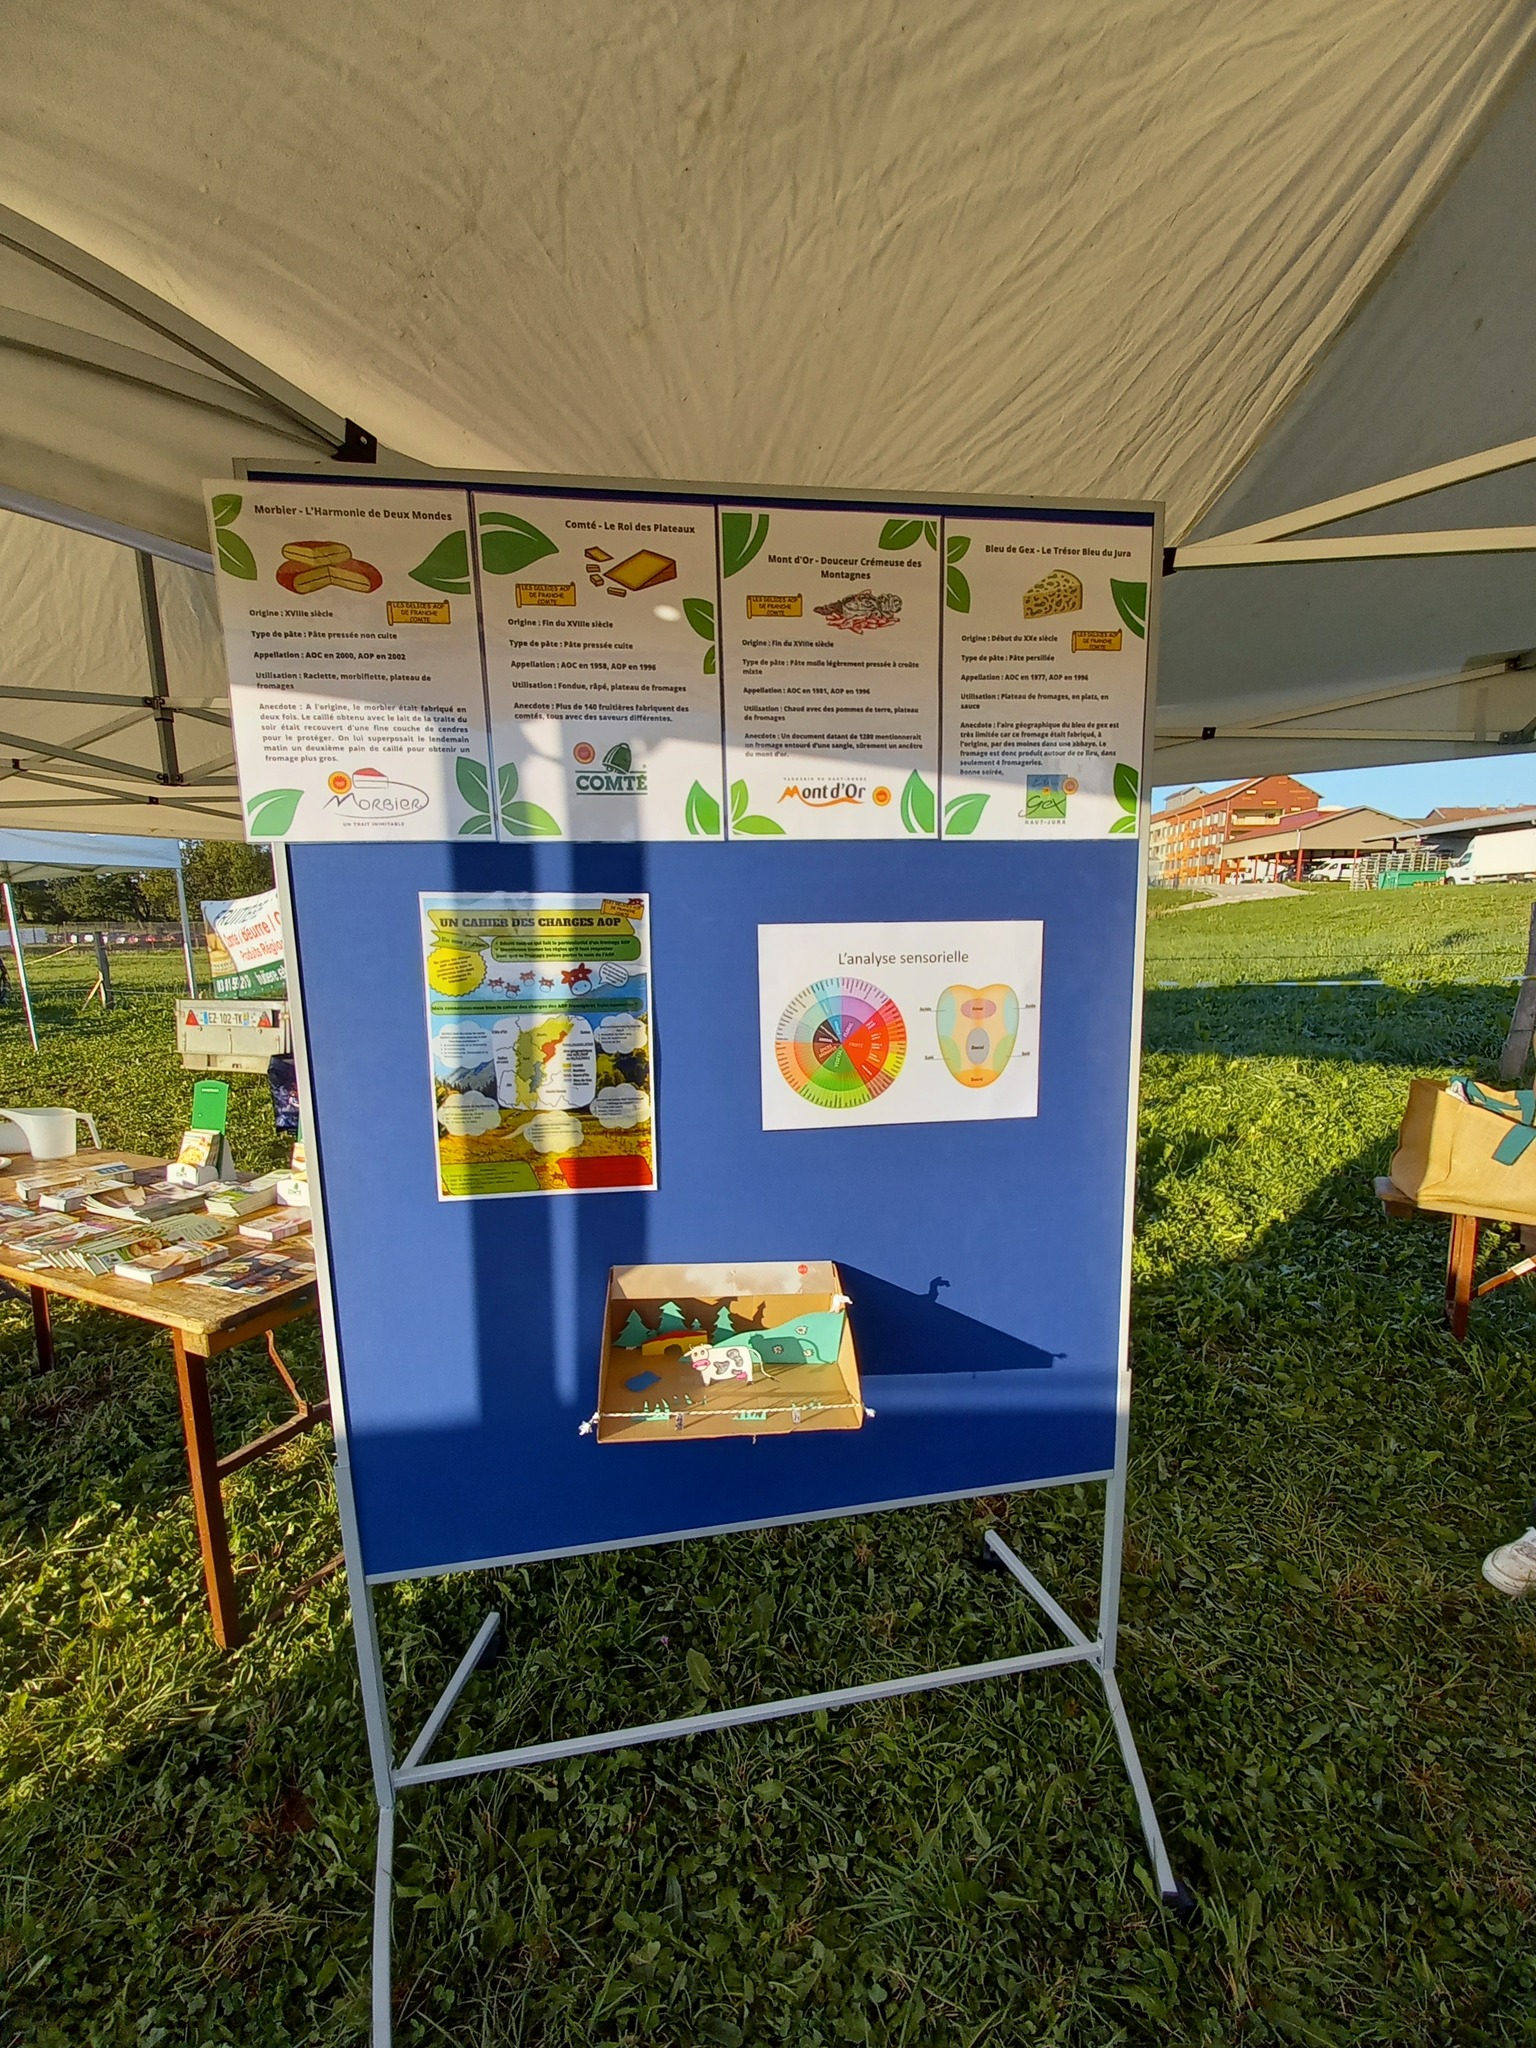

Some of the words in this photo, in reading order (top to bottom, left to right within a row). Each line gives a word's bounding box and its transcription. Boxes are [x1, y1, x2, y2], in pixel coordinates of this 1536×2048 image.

[254, 504, 296, 514] Morbier
[305, 506, 365, 517] L'Harmonie
[368, 508, 381, 517] de
[383, 509, 409, 519] Deux
[412, 510, 452, 520] Mondes
[564, 519, 596, 529] Comté
[604, 521, 615, 530] Le
[617, 521, 632, 530] Roi
[634, 522, 651, 531] des
[653, 523, 695, 533] Plateaux
[985, 544, 1004, 552] Bleu
[1006, 544, 1017, 553] de
[1053, 546, 1080, 555] Trésor
[1082, 547, 1100, 555] Bleu
[1113, 549, 1131, 559] Jura
[767, 554, 792, 563] Mont
[794, 555, 813, 564] d'Or
[820, 556, 858, 565] Douceur
[860, 557, 904, 566] Crémeuse
[906, 558, 921, 567] des
[820, 570, 870, 581] Montagnes
[249, 609, 279, 618] Origine
[507, 618, 536, 627] Origine
[251, 630, 270, 638] Type
[283, 630, 302, 638] pâte
[509, 639, 528, 648] Type
[540, 640, 558, 648] pâte
[582, 641, 612, 650] pressée
[742, 639, 767, 647] Origine
[254, 651, 299, 660] Appellation
[510, 660, 555, 669] Appellation
[389, 674, 419, 682] plateau
[589, 682, 609, 691] râpé,
[610, 683, 639, 692] plateau
[651, 684, 686, 693] fromages
[314, 703, 349, 711] l'origine,
[418, 705, 455, 713] fabriqué
[576, 774, 648, 791] COMTÉ
[783, 783, 828, 799] Mont
[830, 783, 866, 799] d'Or
[440, 918, 460, 927] UN
[460, 918, 508, 927] CAHIER
[511, 917, 534, 927] DES
[538, 917, 595, 926] CHARGES
[595, 917, 622, 926] AOP
[242, 922, 270, 942] Beurre
[838, 952, 895, 966] L'analyse
[900, 950, 968, 963] sensorielle
[209, 1012, 242, 1024] EZ-102-TK
